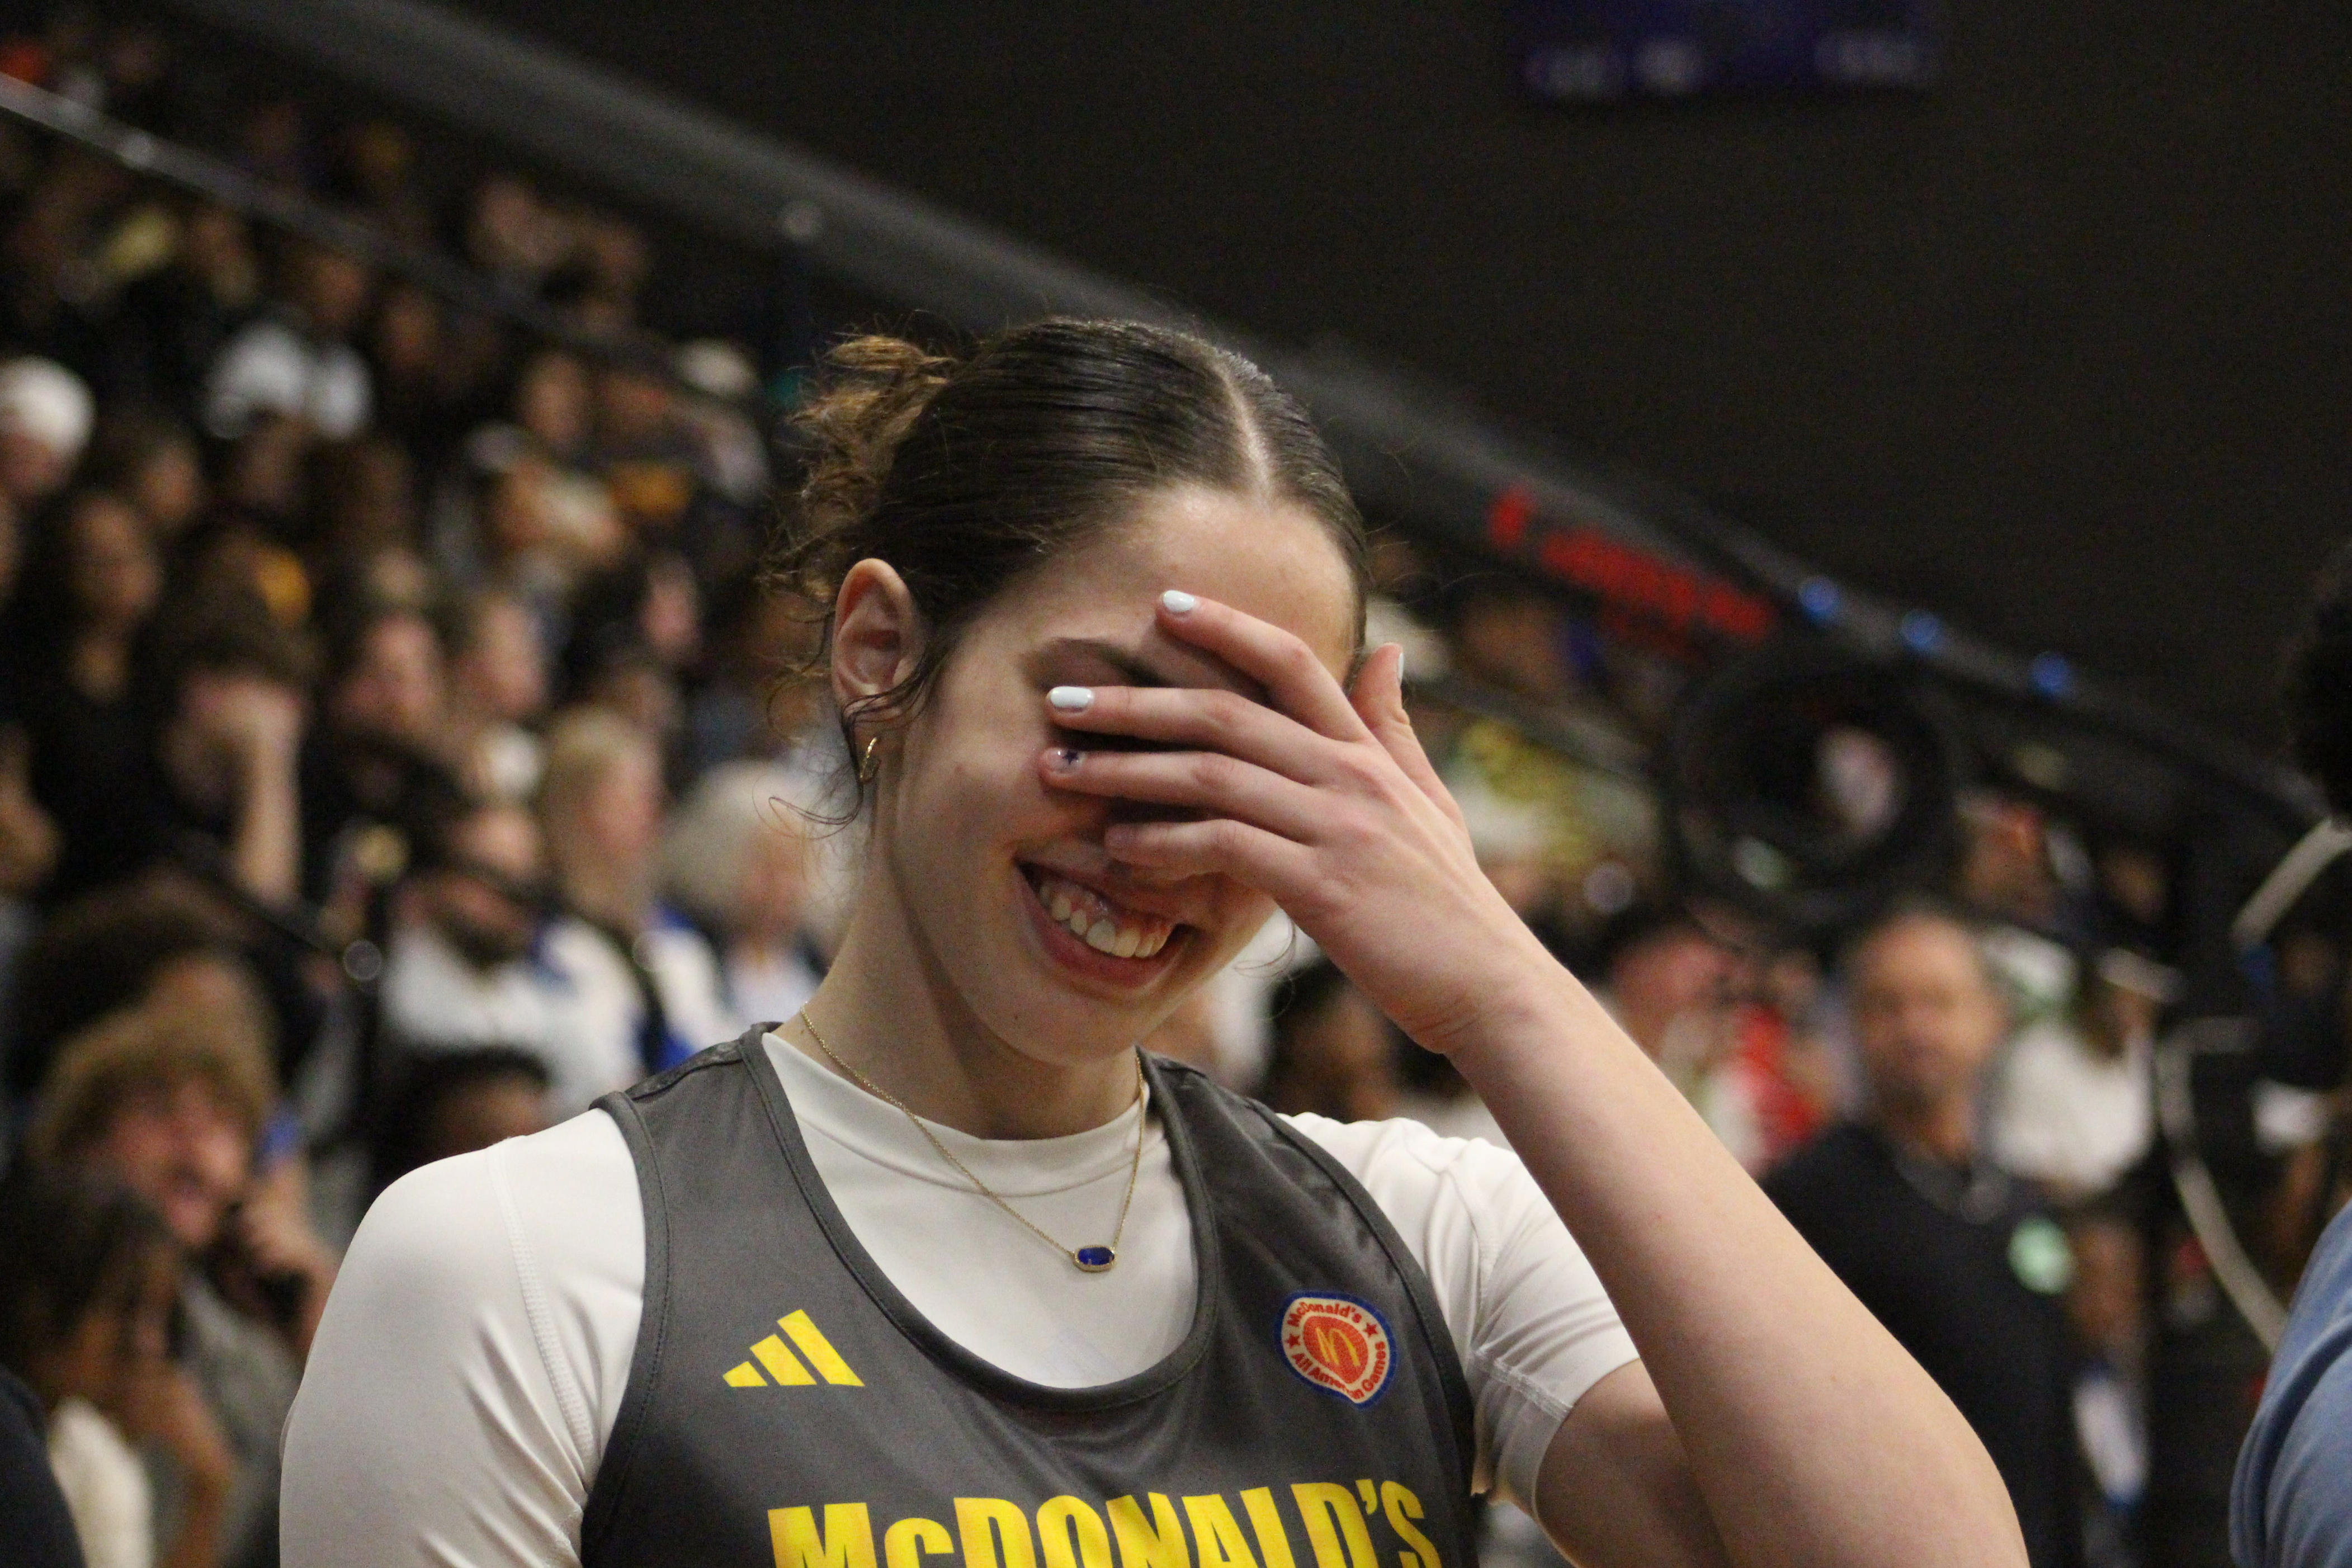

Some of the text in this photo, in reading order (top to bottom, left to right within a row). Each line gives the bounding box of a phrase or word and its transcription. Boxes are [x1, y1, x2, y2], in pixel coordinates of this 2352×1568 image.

[1287, 1302, 1362, 1327] McDonald's
[1291, 1342, 1386, 1399] All Ameran Games
